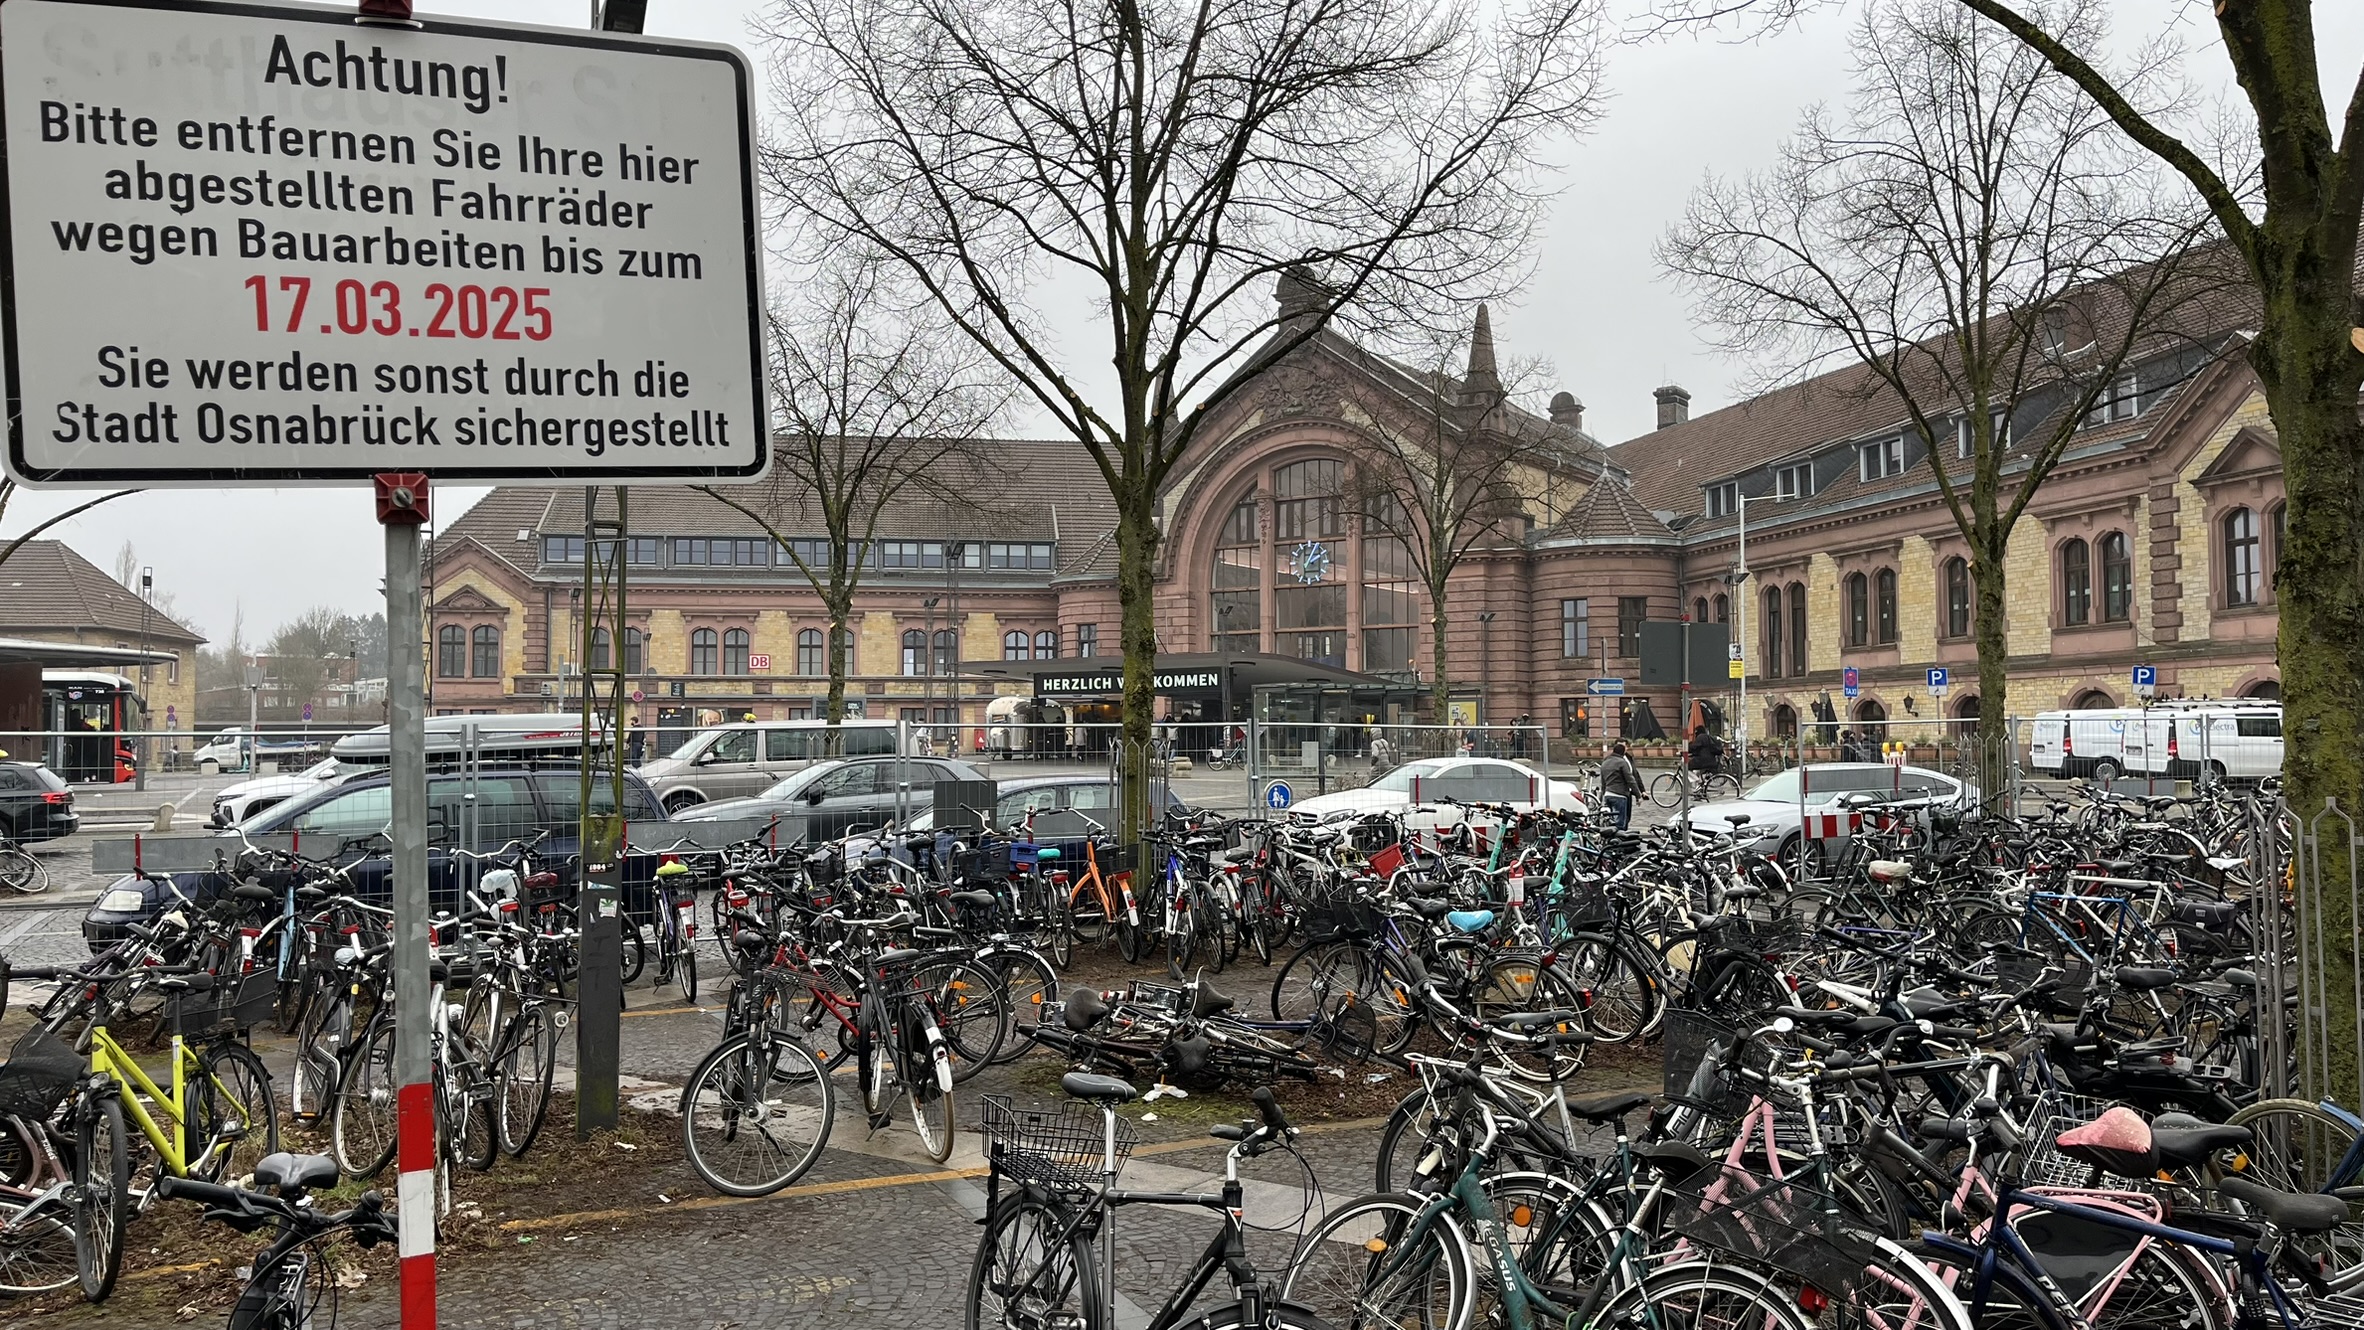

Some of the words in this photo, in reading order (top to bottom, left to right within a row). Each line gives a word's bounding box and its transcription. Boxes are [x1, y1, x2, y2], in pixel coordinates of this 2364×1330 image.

[265, 35, 507, 114] Achtung!
[41, 101, 157, 147] Bitte
[178, 116, 415, 164] entfernen
[433, 129, 500, 170] Sie
[519, 135, 603, 177] Ihre
[620, 143, 699, 184] hier
[106, 160, 413, 215] abgestellten
[433, 179, 652, 229] Fahrräder
[51, 222, 217, 265] wegen
[239, 218, 524, 271] Bauarbeiten
[542, 236, 603, 274] bis
[619, 250, 701, 279] zum
[246, 276, 551, 340] 17.03.2025
[98, 346, 169, 388] Sie
[186, 351, 357, 392] werden
[375, 359, 489, 394] sonst
[506, 357, 618, 396] durch
[635, 361, 689, 398] die
[53, 401, 179, 443] Stadt
[198, 403, 440, 445] Osnabrück
[455, 407, 729, 456] sichergestellt
[751, 656, 768, 667] DB
[1043, 677, 1112, 691] HERZLICH
[1117, 673, 1218, 689] WKOMMEN
[1931, 670, 1943, 685] P
[2137, 668, 2150, 684] P
